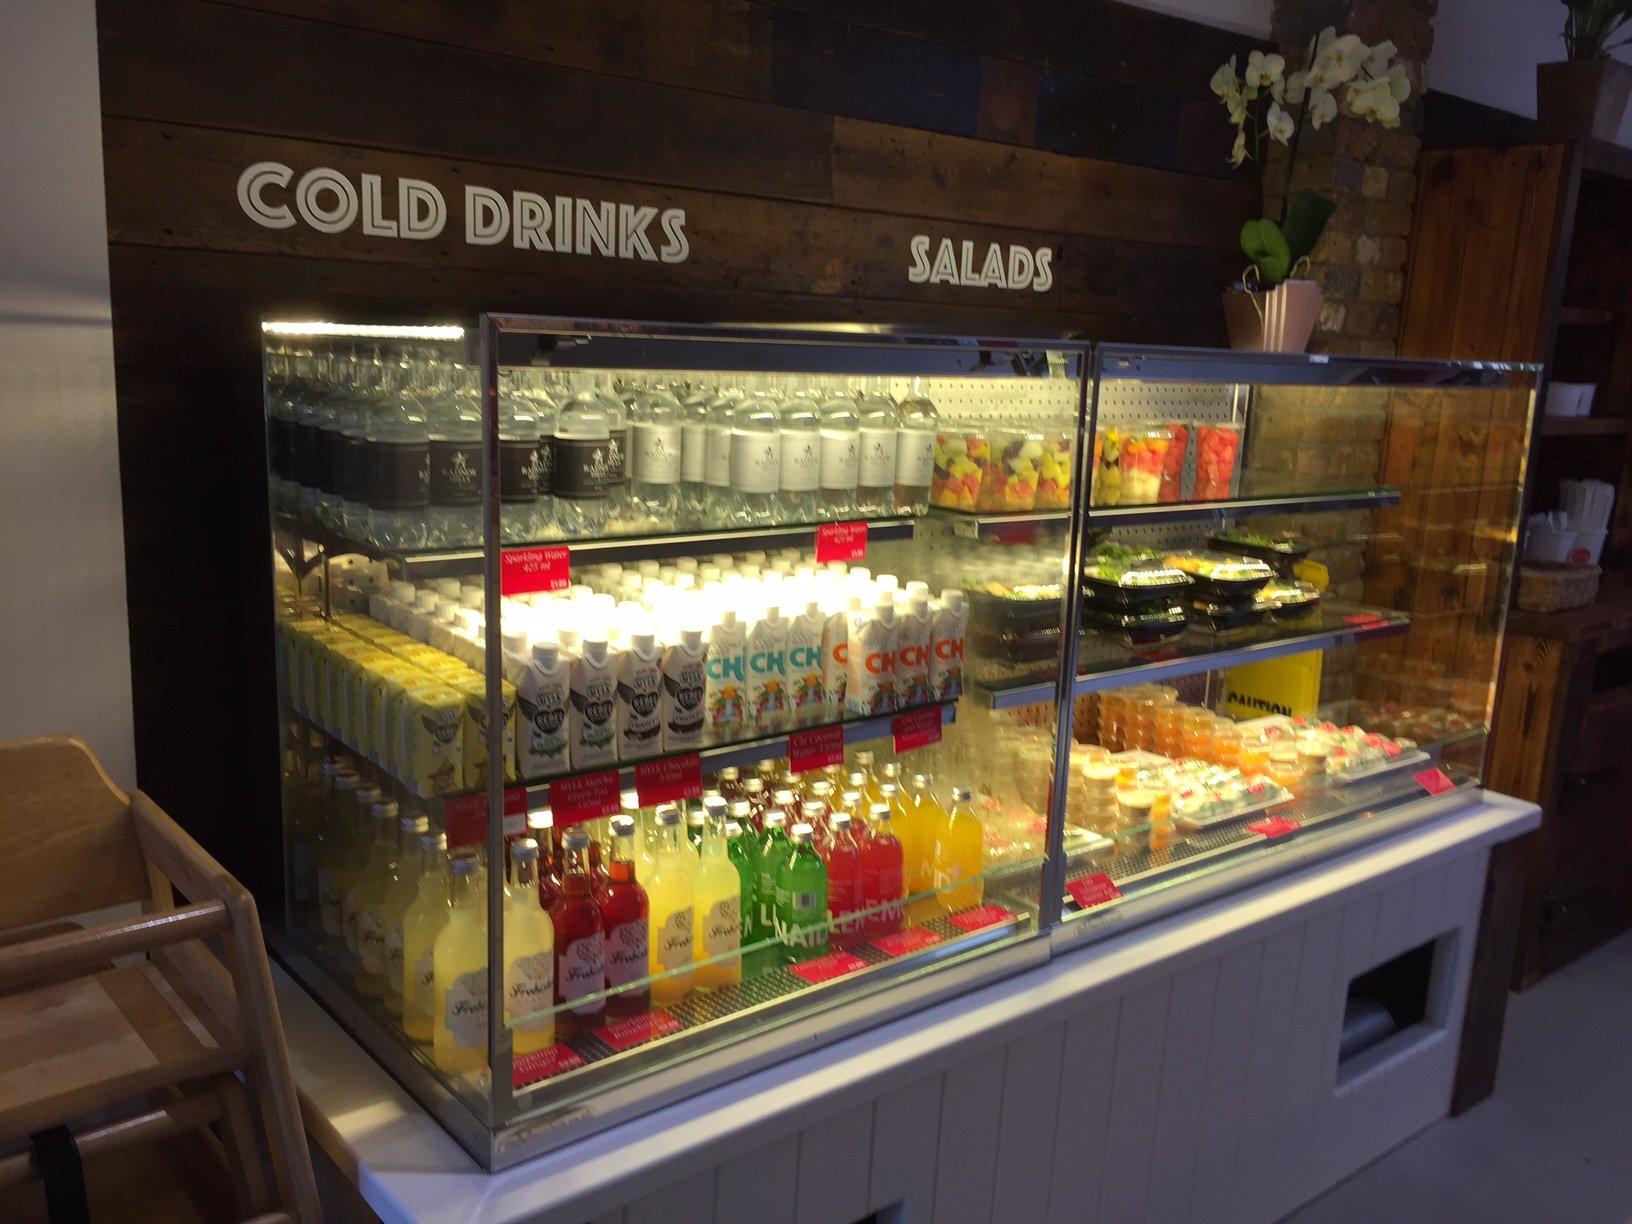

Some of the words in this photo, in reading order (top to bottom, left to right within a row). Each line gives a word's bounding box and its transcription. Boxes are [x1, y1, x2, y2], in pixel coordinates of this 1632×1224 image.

[237, 161, 447, 240] COLD
[465, 184, 690, 264] DRINKS
[908, 234, 1053, 293] SALADS
